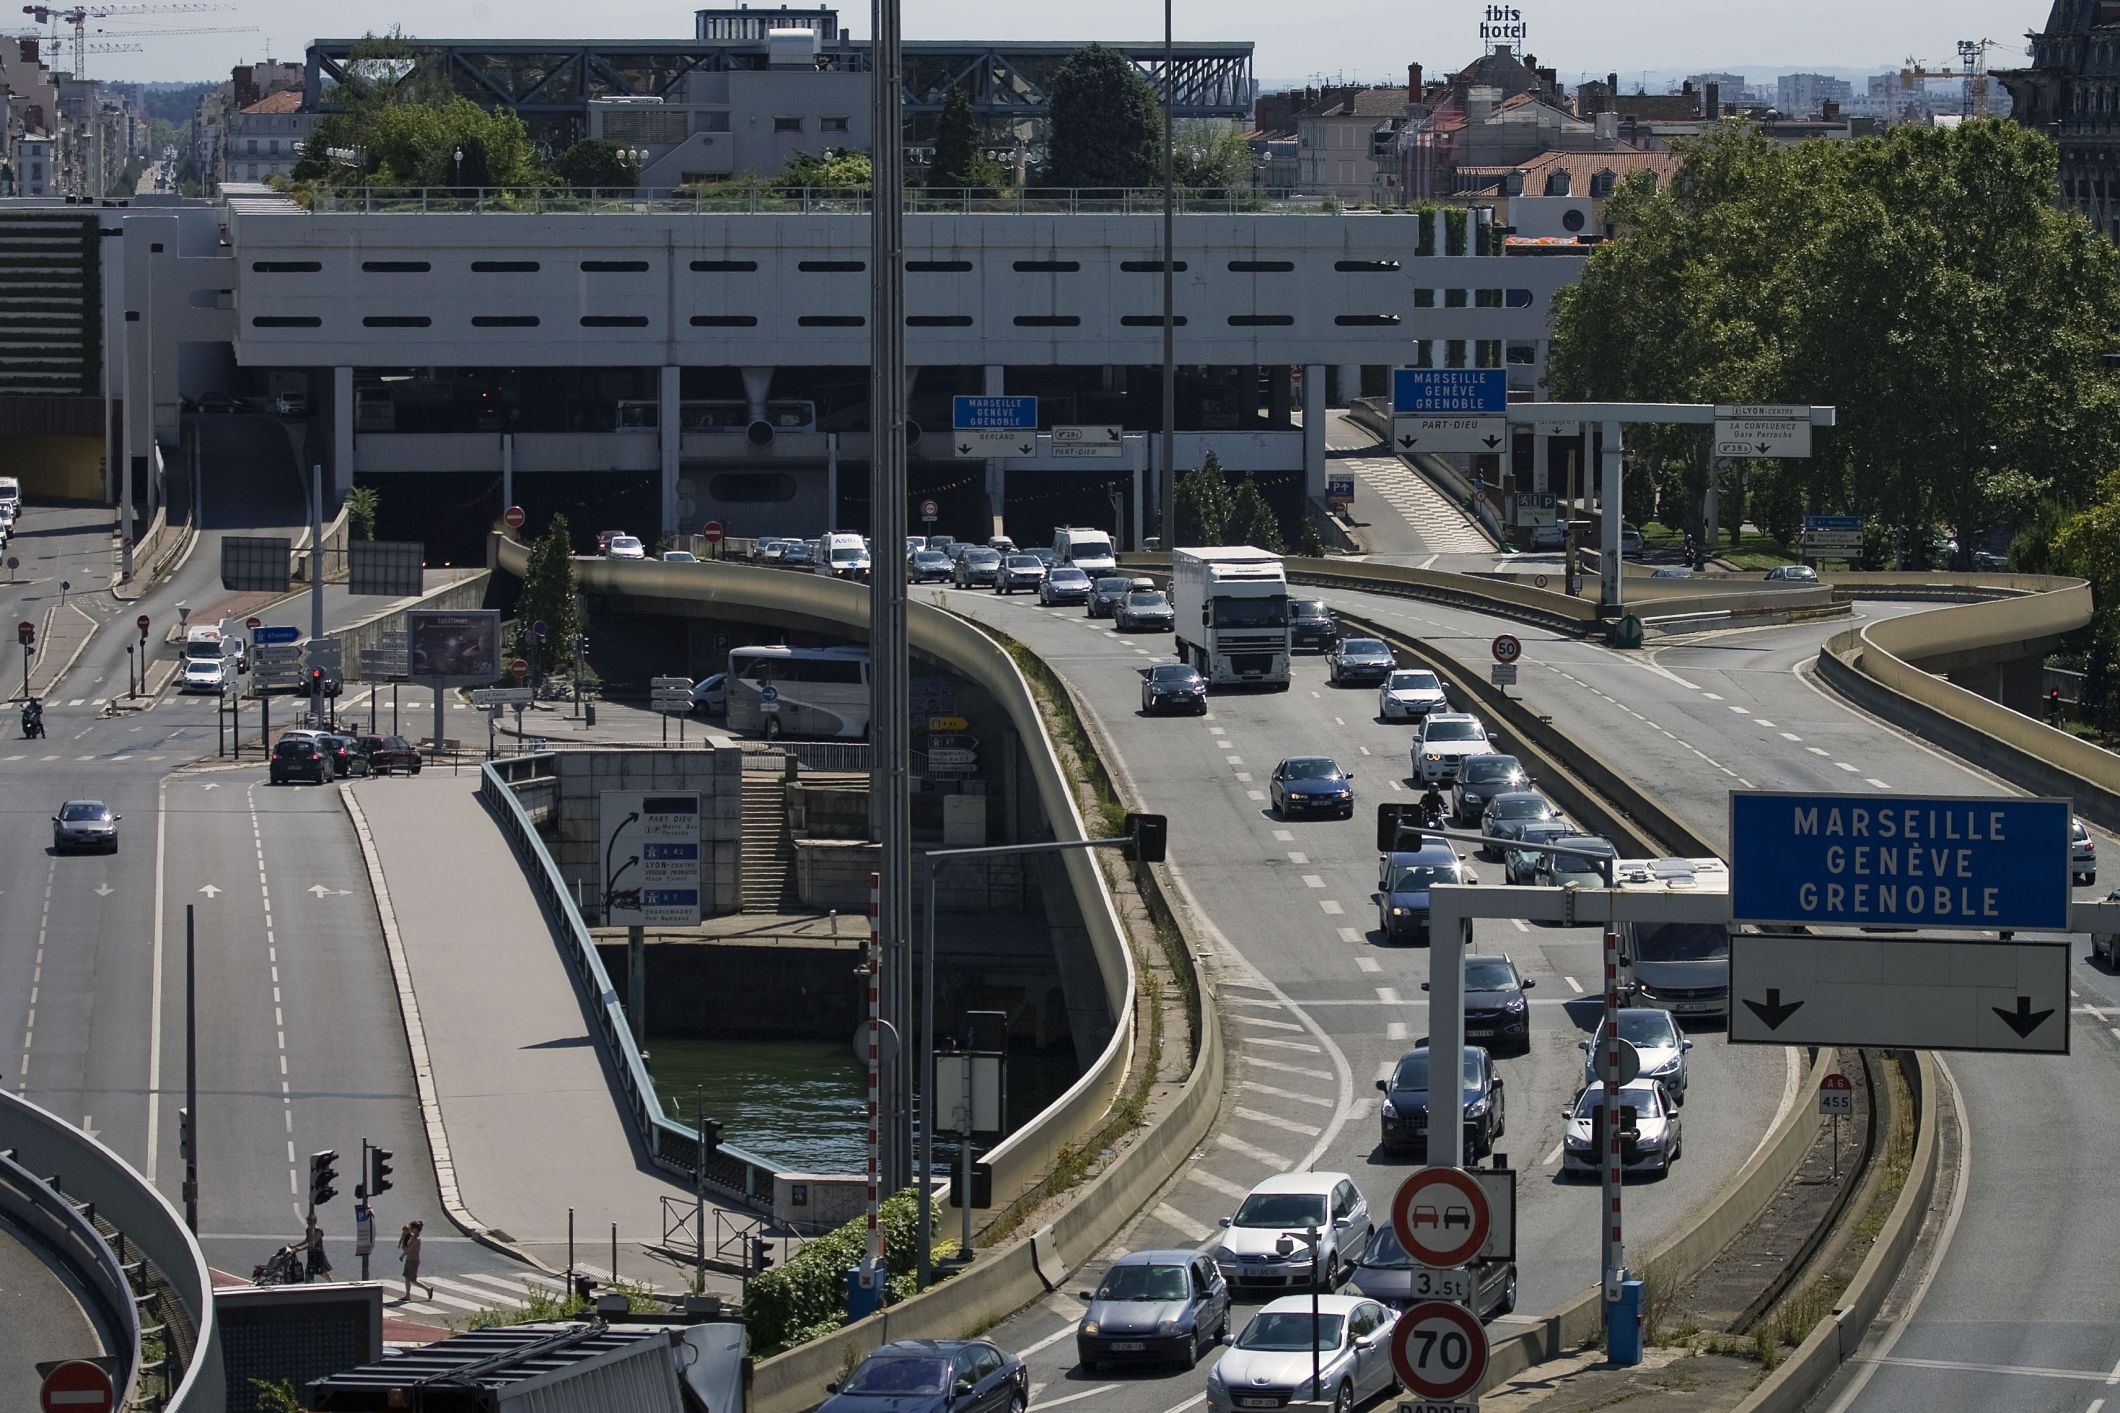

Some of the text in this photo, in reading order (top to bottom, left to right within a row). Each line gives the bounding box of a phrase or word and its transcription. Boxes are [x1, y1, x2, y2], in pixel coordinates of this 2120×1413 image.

[1487, 5, 1520, 21] ibis
[1480, 22, 1526, 38] hotel
[1414, 373, 1486, 384] MARSEILLE
[1425, 384, 1475, 396] GENÈVE
[969, 399, 1022, 407] MARSEILLE
[1416, 399, 1484, 409] GRENOBLE
[977, 407, 1014, 417] GENÈVE
[970, 418, 1021, 426] GRENOBLE
[1422, 420, 1478, 429] PART-DIEU
[1744, 422, 1797, 430] CONFLUENCE
[1734, 430, 1753, 438] Gare
[1055, 448, 1096, 456] PART-DIEU
[1544, 497, 1552, 507] P
[1498, 642, 1515, 655] 50
[673, 815, 693, 823] DIEU
[1793, 807, 2006, 841] MARSEILLE
[1826, 842, 1972, 878] GENÈVE
[1799, 882, 1999, 916] GRENOBLE
[1827, 1079, 1844, 1088] A 6
[1822, 1096, 1849, 1108] 455
[1417, 1273, 1462, 1296] 3.5t
[1413, 1330, 1468, 1370] 70
